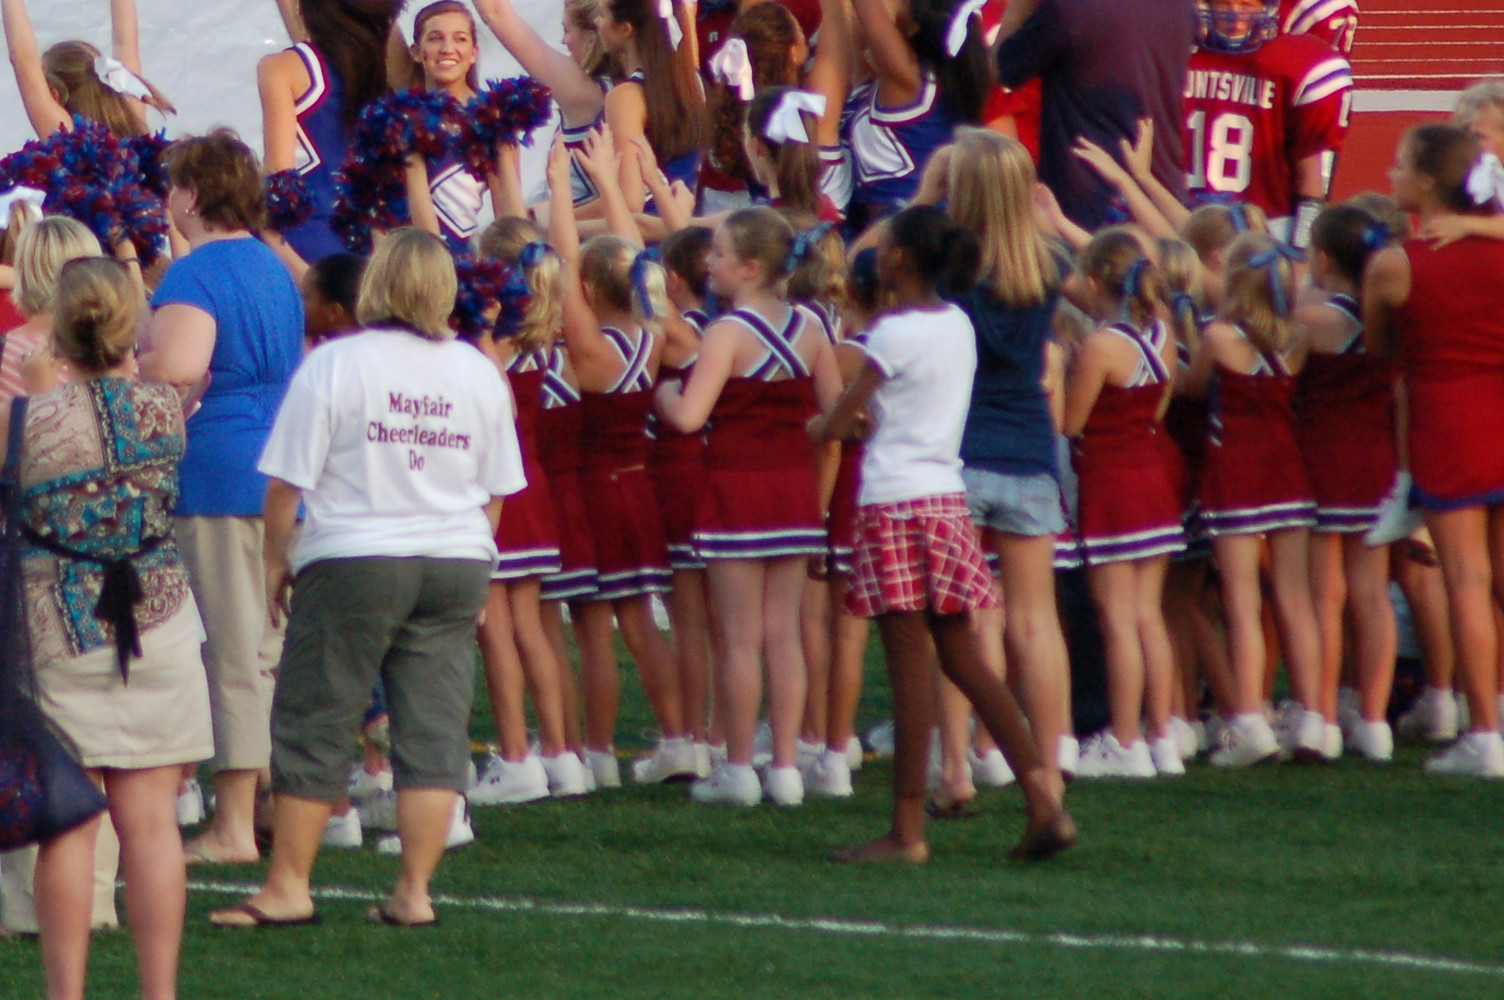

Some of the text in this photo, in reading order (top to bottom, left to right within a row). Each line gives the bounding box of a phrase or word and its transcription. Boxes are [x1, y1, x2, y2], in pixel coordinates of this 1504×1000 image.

[1186, 110, 1254, 193] 18
[389, 391, 453, 419] Mayfair
[367, 421, 471, 450] Cheerleaders
[409, 450, 425, 471] Do
